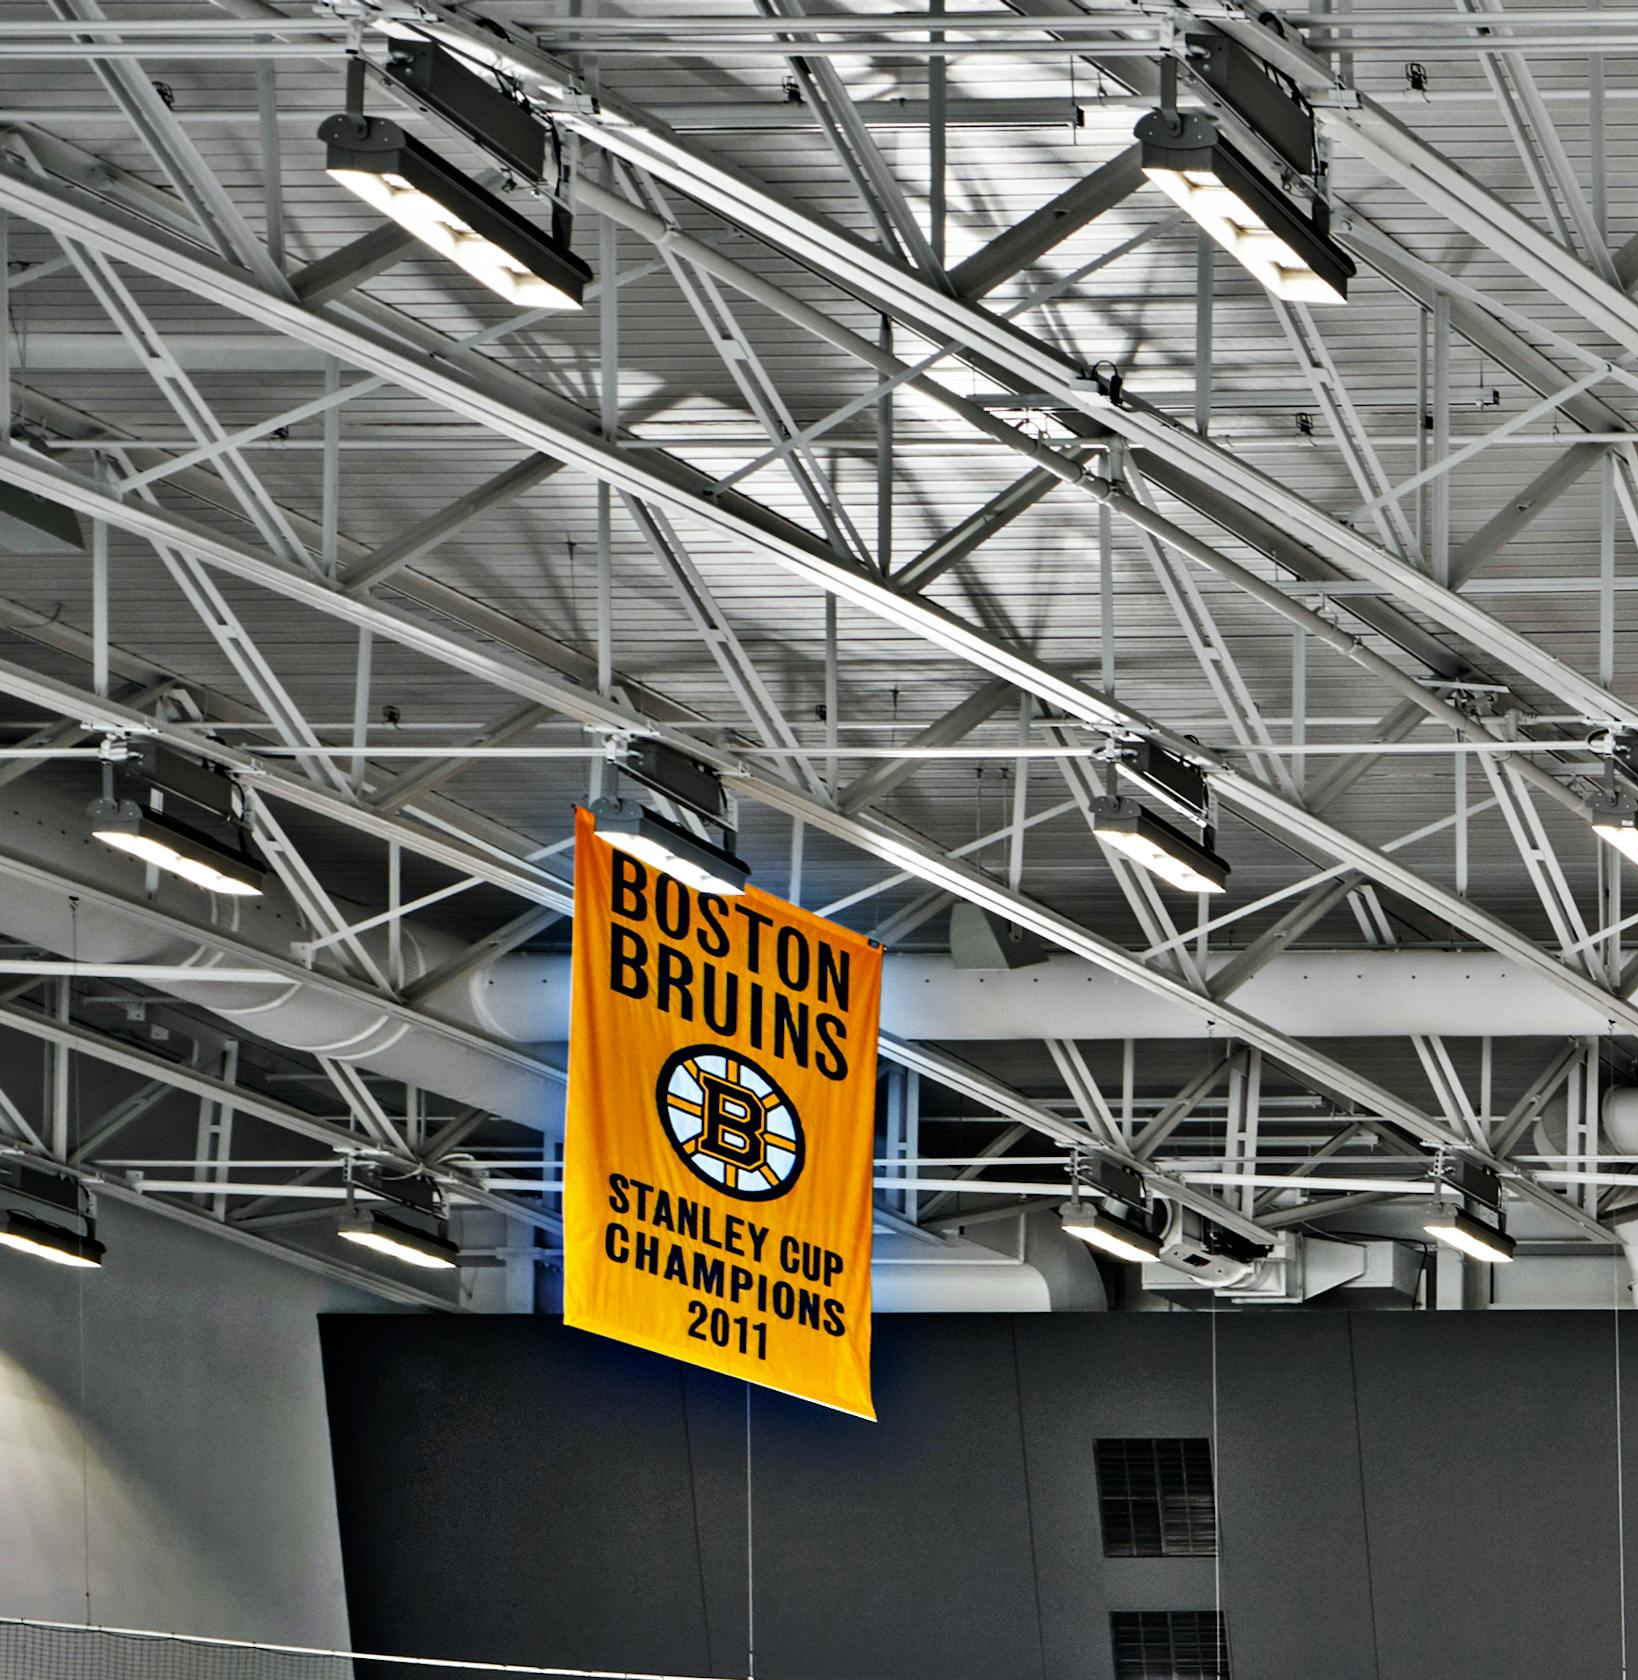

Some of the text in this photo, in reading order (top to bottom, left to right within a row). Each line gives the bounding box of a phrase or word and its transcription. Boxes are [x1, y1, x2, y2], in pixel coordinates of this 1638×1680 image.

[611, 848, 850, 1012] BOSTON
[610, 922, 849, 1081] BRUINS
[605, 1223, 846, 1337] CHAMPIONS
[609, 1172, 844, 1287] STANLEY CUP
[687, 1300, 768, 1361] 2011
